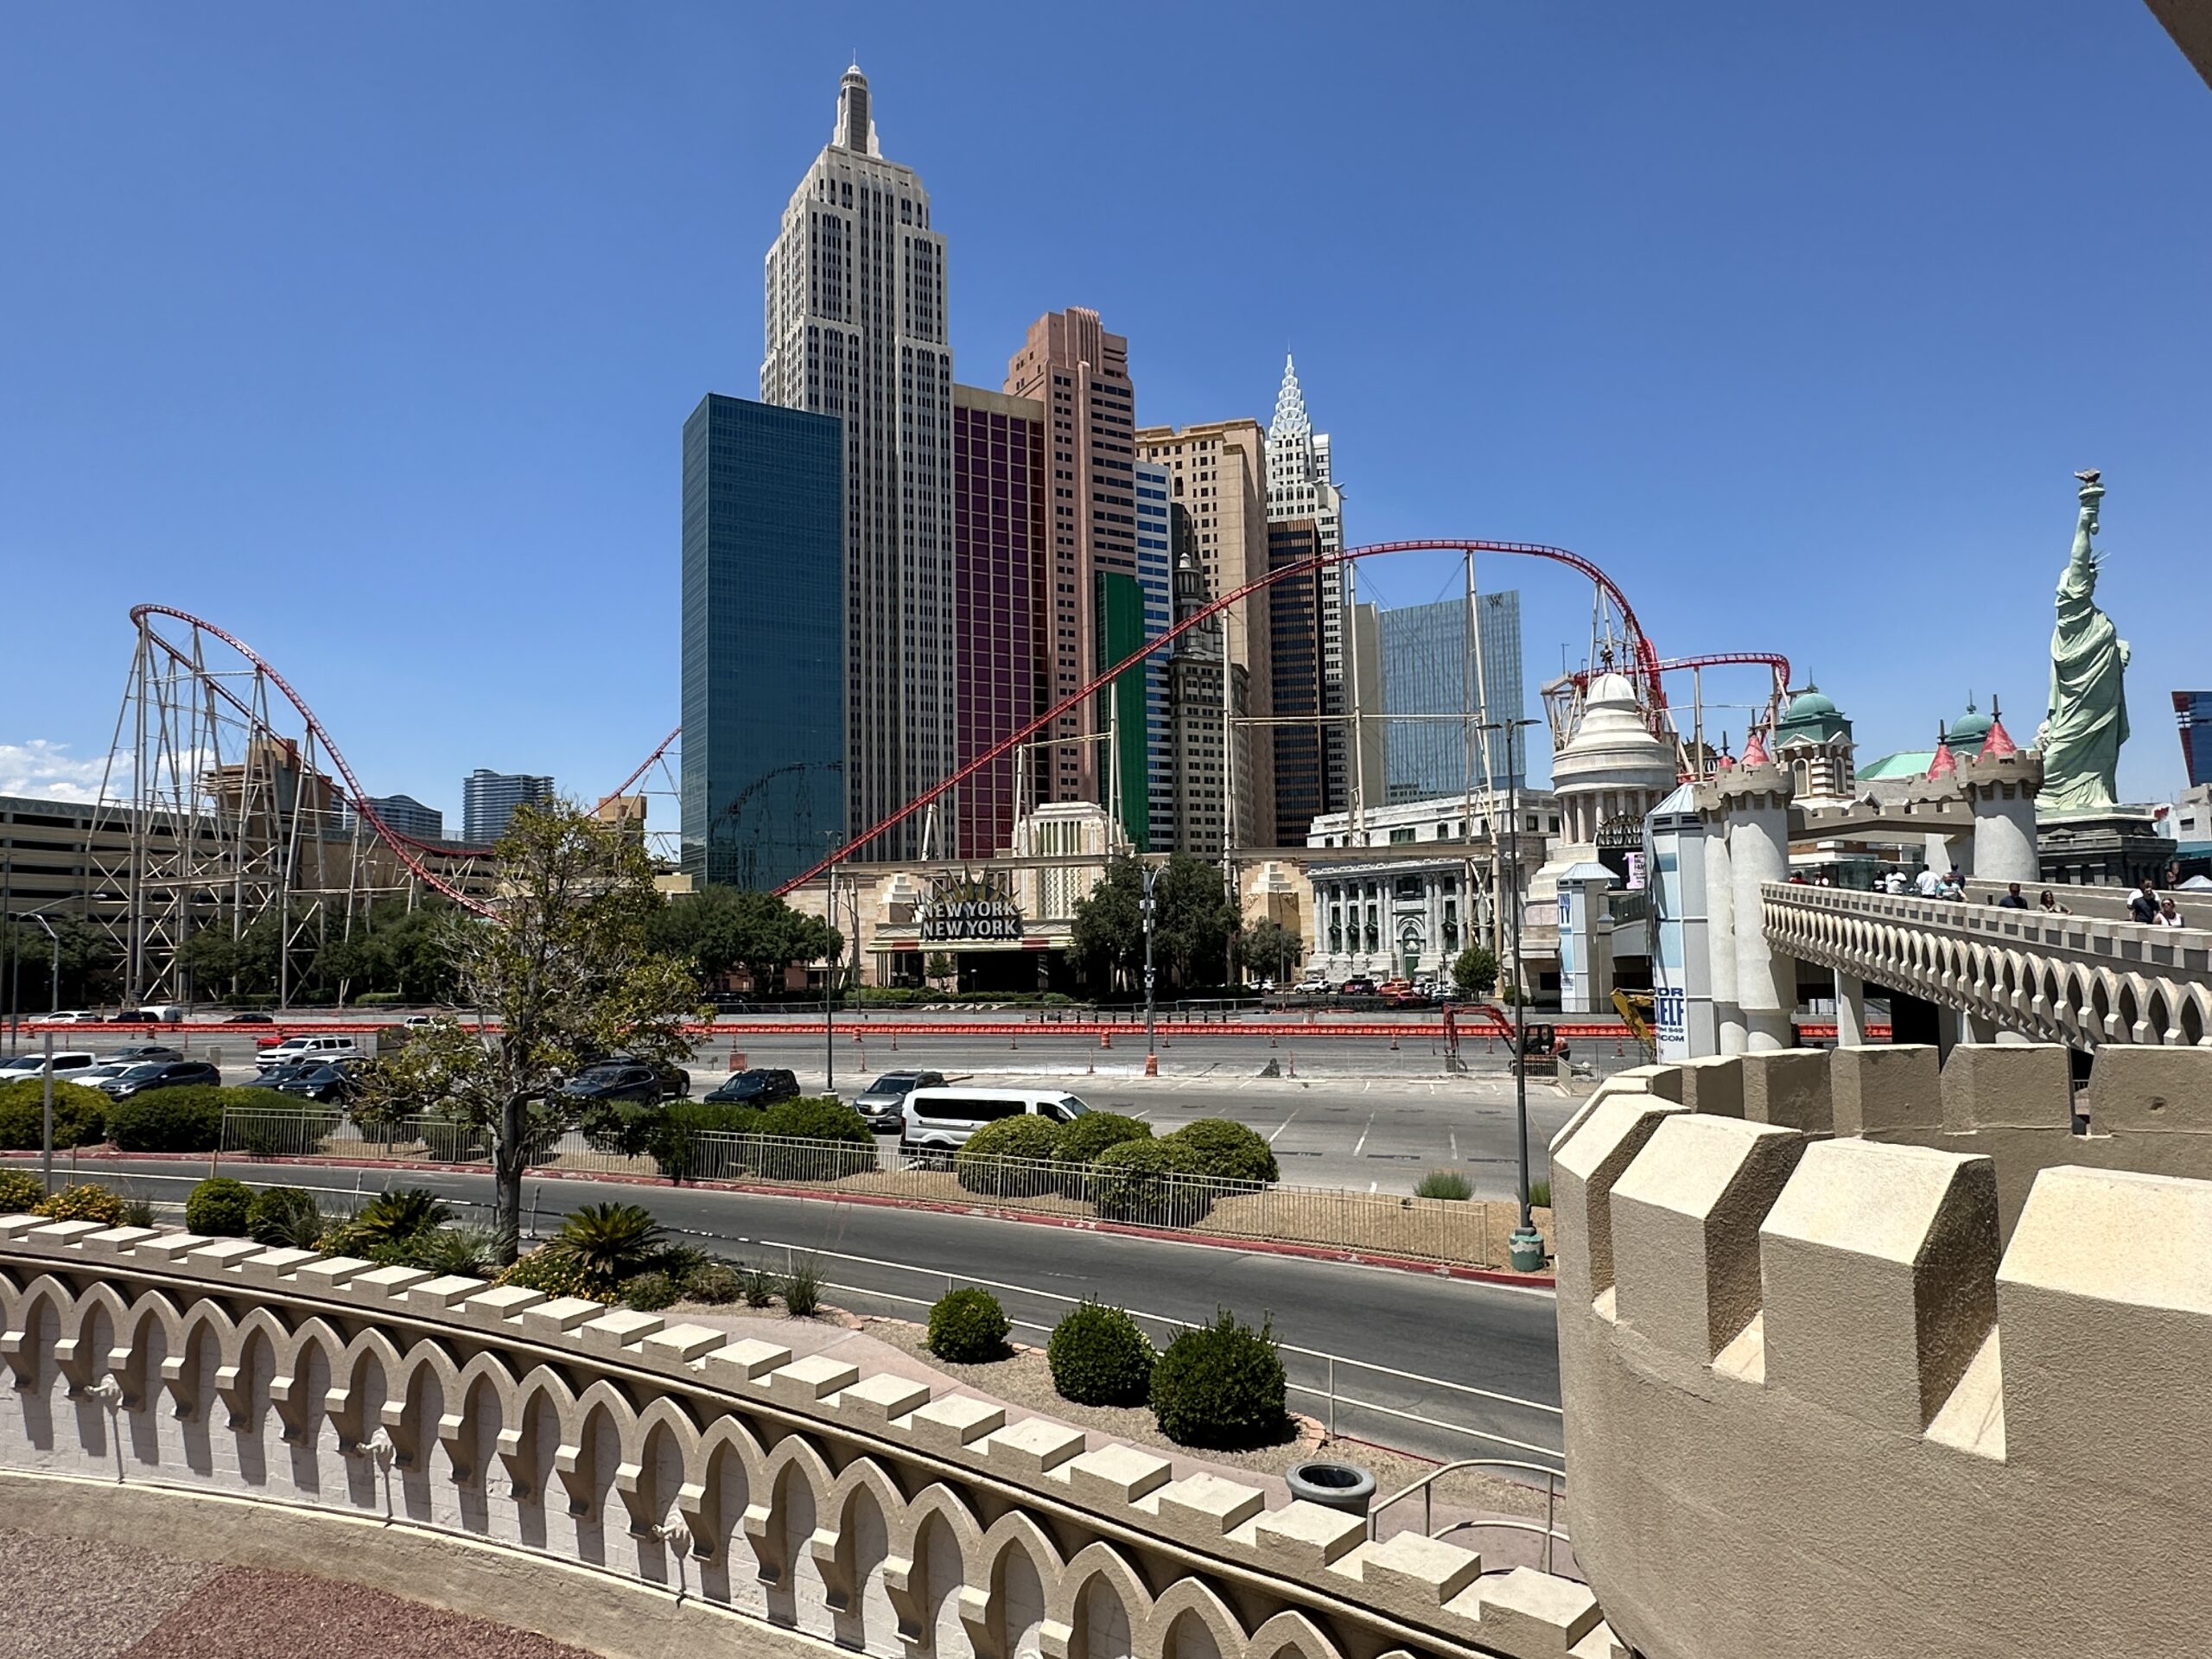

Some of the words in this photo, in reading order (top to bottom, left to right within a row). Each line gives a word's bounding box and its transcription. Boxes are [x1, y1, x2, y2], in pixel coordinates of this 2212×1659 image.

[1598, 823, 1623, 836] NEW
[1597, 836, 1623, 846] NEW
[924, 901, 963, 918] NEW
[966, 900, 1018, 917] YORK
[922, 920, 963, 937] NEW
[965, 919, 1018, 935] YORK
[1656, 997, 1685, 1027] ELF
